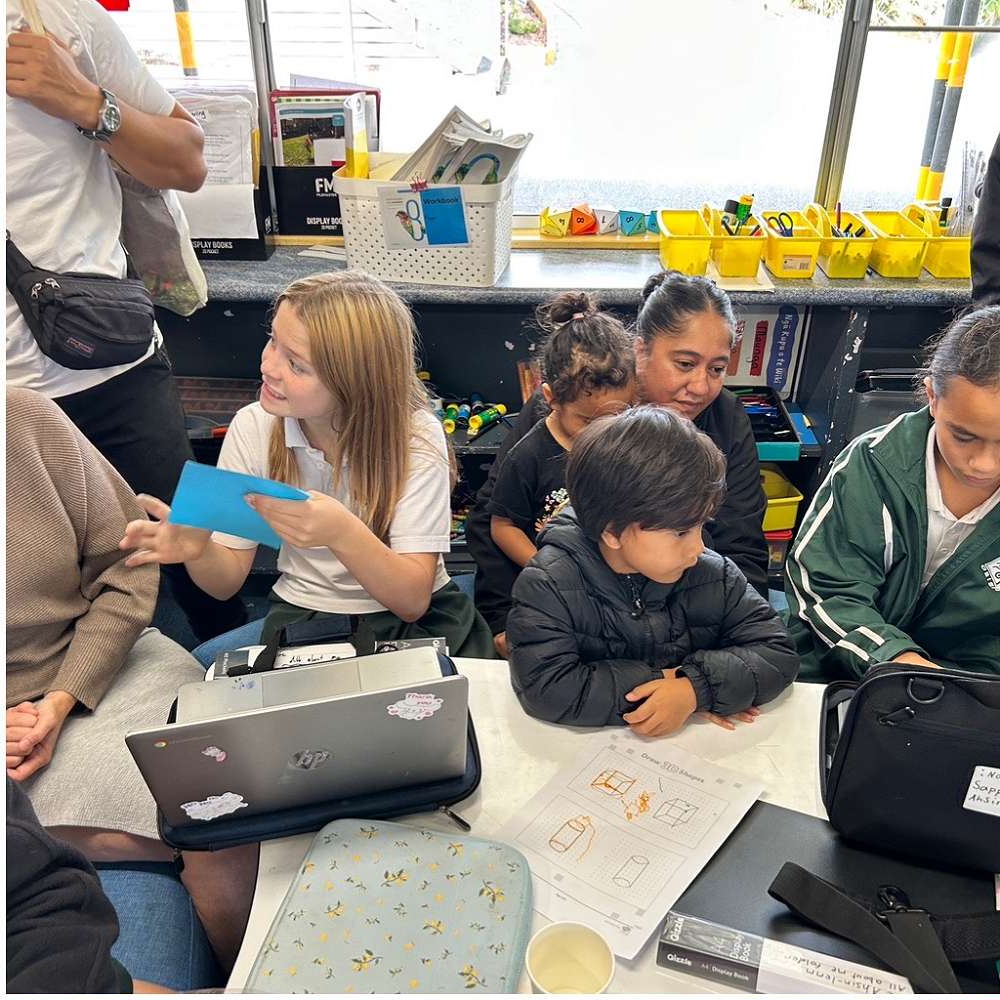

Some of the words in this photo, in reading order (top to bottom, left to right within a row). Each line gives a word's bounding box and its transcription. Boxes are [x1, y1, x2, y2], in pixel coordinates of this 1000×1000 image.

[306, 217, 329, 225] DISPLAY
[213, 241, 233, 249] BOOKS
[640, 752, 661, 766] Draw
[667, 953, 692, 966] Qizzle
